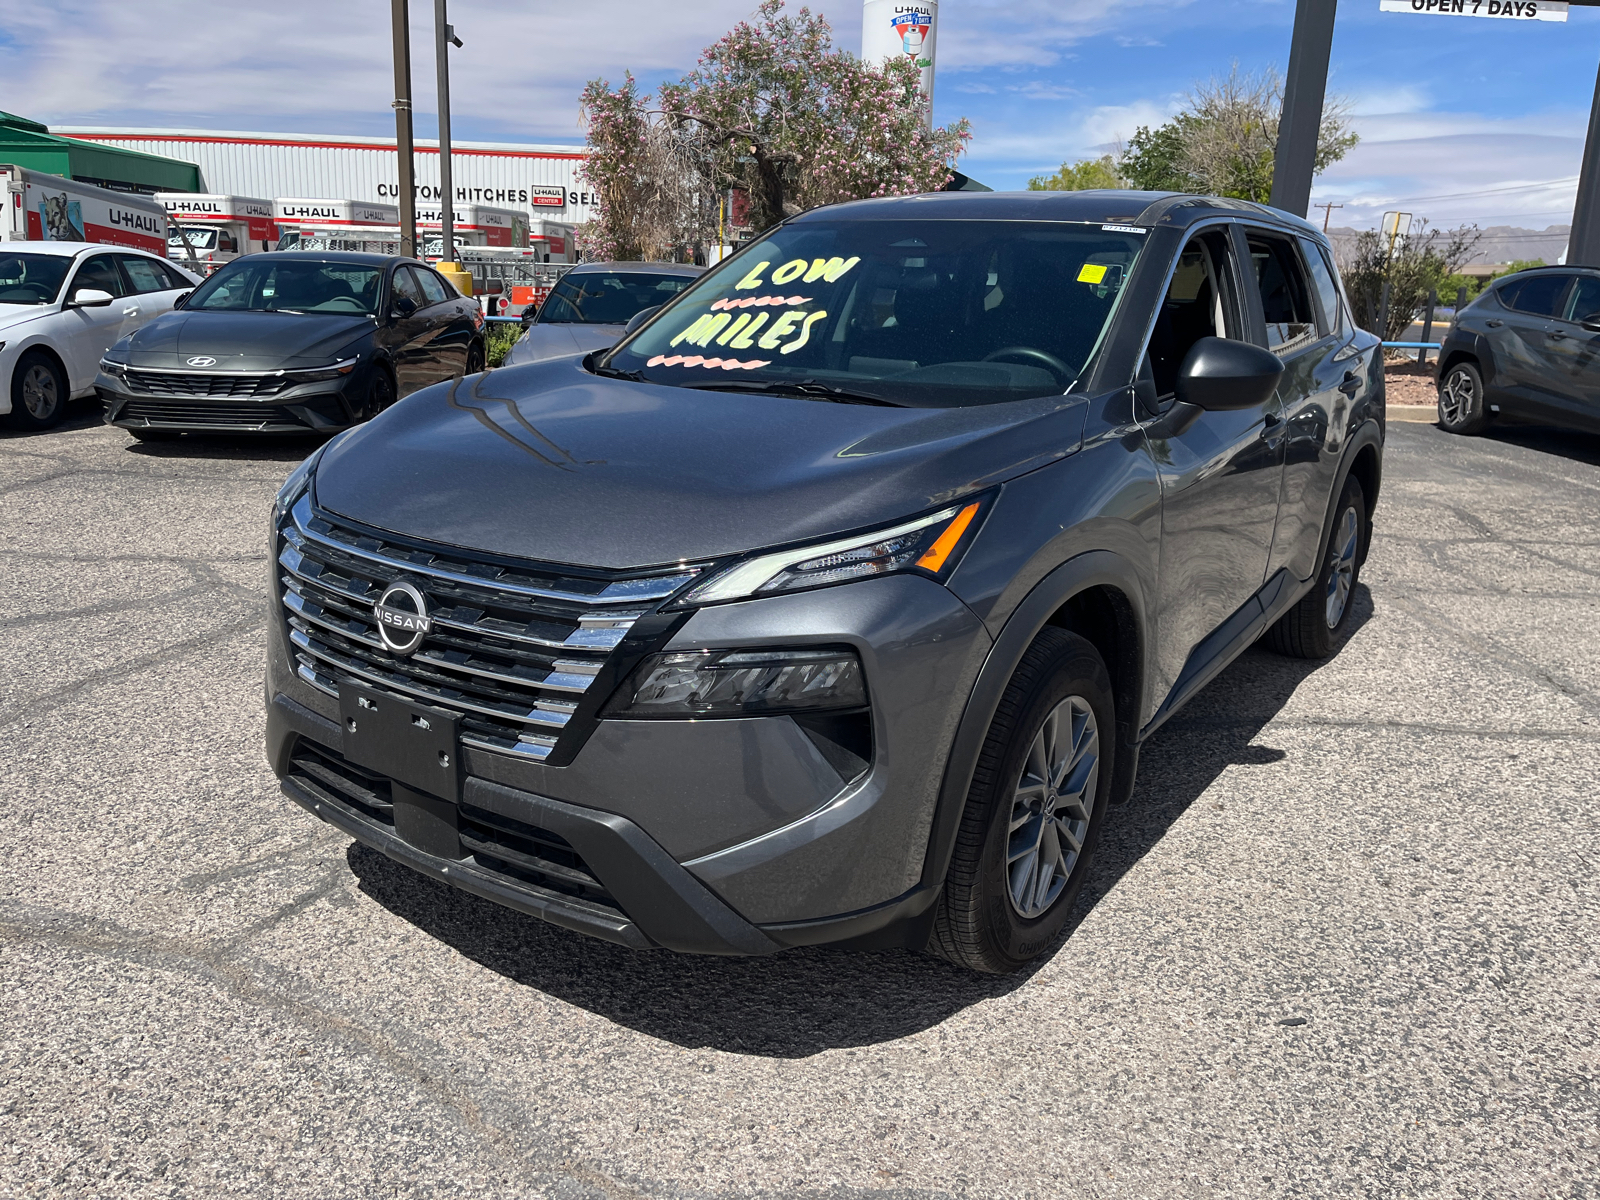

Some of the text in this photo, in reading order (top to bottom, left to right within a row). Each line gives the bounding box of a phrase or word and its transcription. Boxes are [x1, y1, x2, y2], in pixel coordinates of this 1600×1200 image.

[895, 6, 931, 15] U-HAUL
[1411, 0, 1538, 17] OPEN 7 DAYS
[896, 15, 912, 24] OPEN
[377, 183, 528, 202] CUTOM HITCHES
[109, 208, 161, 234] U-HAUL
[283, 206, 340, 218] U-HAUL
[734, 256, 862, 290] LOW
[669, 310, 828, 355] MILES
[374, 606, 429, 631] NISSAN
